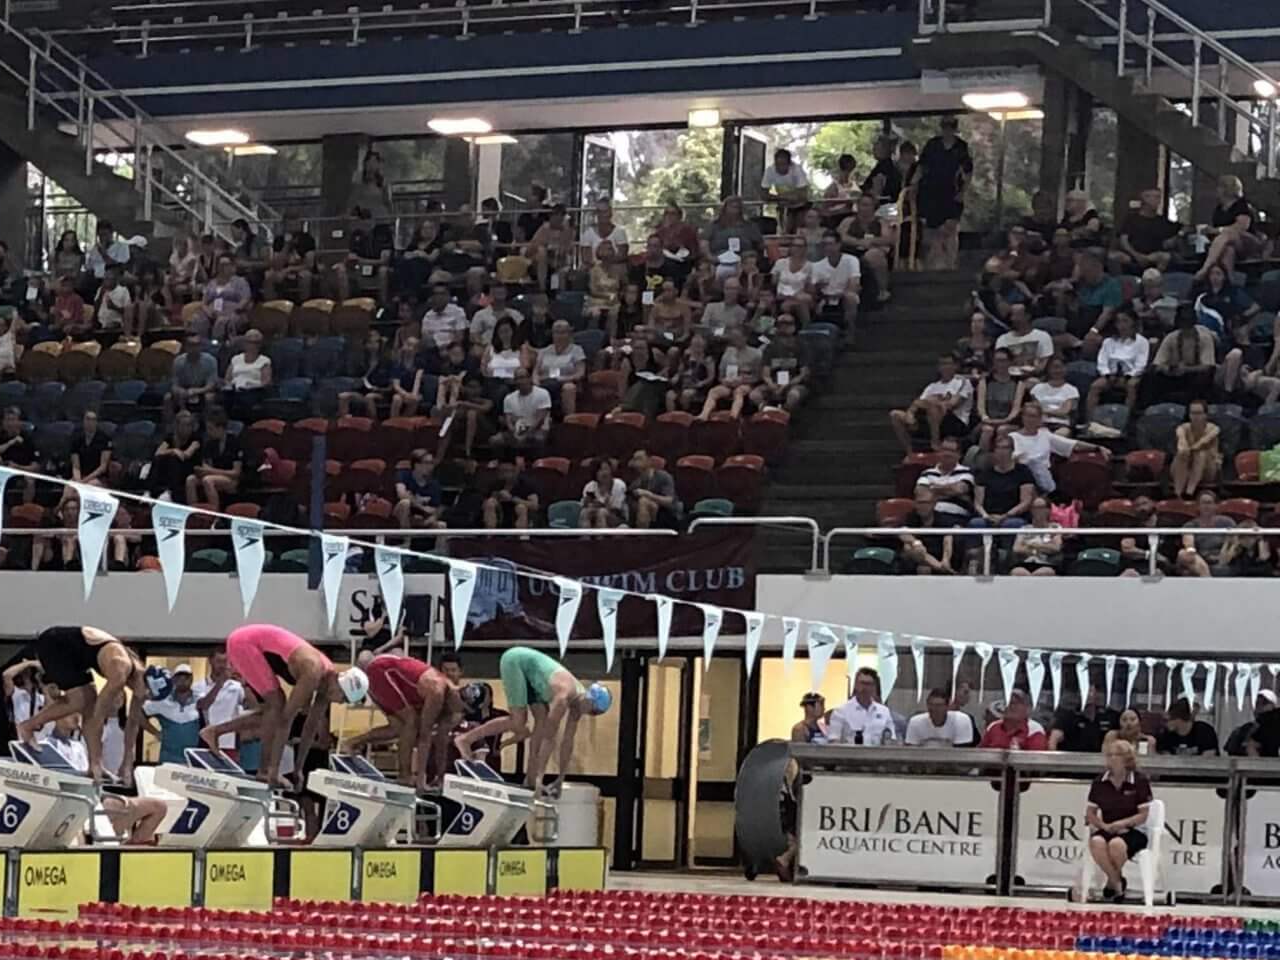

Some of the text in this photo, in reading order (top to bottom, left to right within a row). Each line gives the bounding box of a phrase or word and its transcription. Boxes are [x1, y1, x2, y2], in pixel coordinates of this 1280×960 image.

[666, 566, 746, 593] CLUB
[171, 771, 221, 789] BRISBANE
[3, 804, 18, 828] 6
[185, 807, 198, 829] 7
[337, 810, 349, 830] 8
[461, 811, 474, 831] 9
[817, 835, 983, 857] AQUATIC CENTRE
[24, 866, 68, 887] OMEGA
[210, 864, 247, 883] OMEGA
[366, 861, 398, 879] OMEGA
